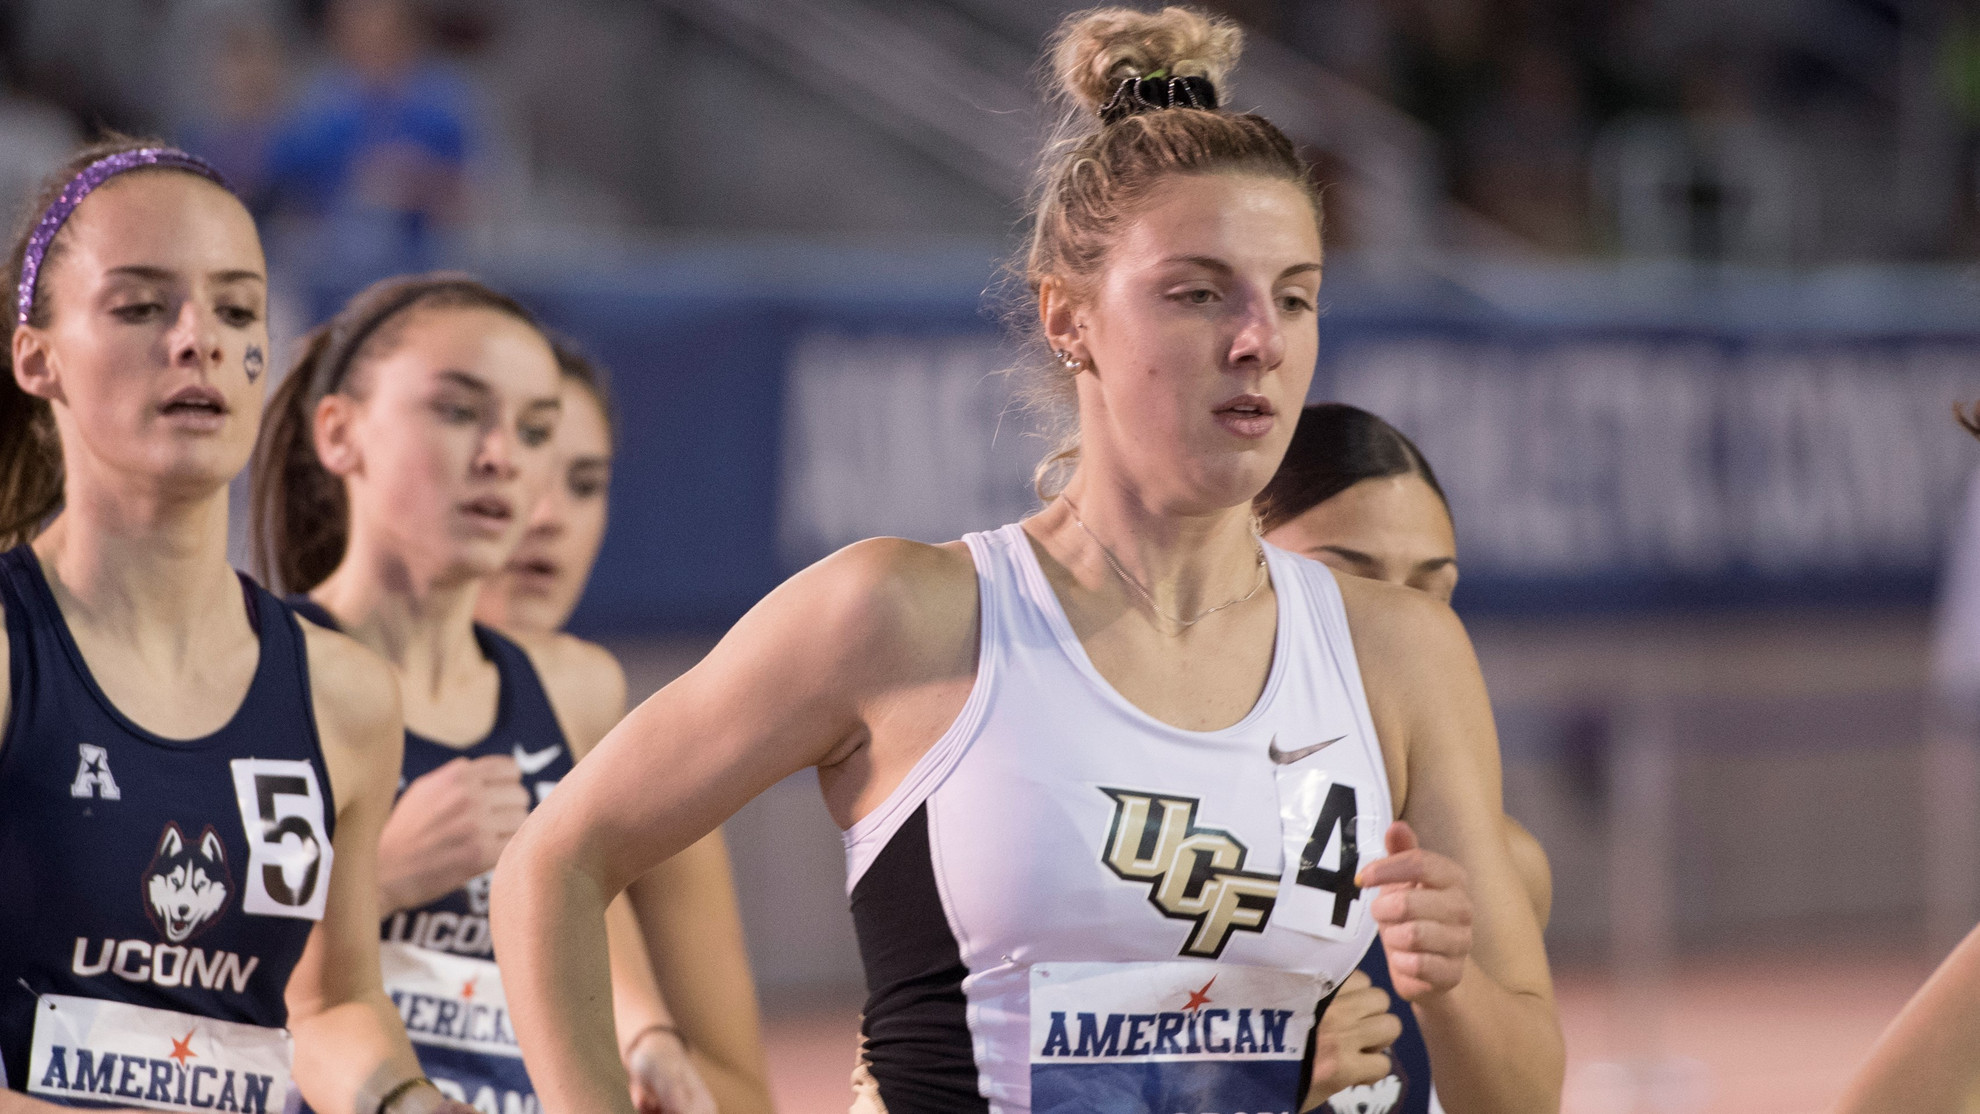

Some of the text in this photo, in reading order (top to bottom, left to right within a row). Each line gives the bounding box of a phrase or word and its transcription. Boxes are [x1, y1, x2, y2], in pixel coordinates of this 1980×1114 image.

[254, 774, 320, 906] 5
[1096, 786, 1281, 960] UCF
[1296, 782, 1362, 928] 4
[72, 936, 259, 993] UCONN
[389, 911, 495, 955] UCO
[1041, 1008, 1293, 1056] AMERICAN
[41, 1045, 273, 1114] AMERICAN
